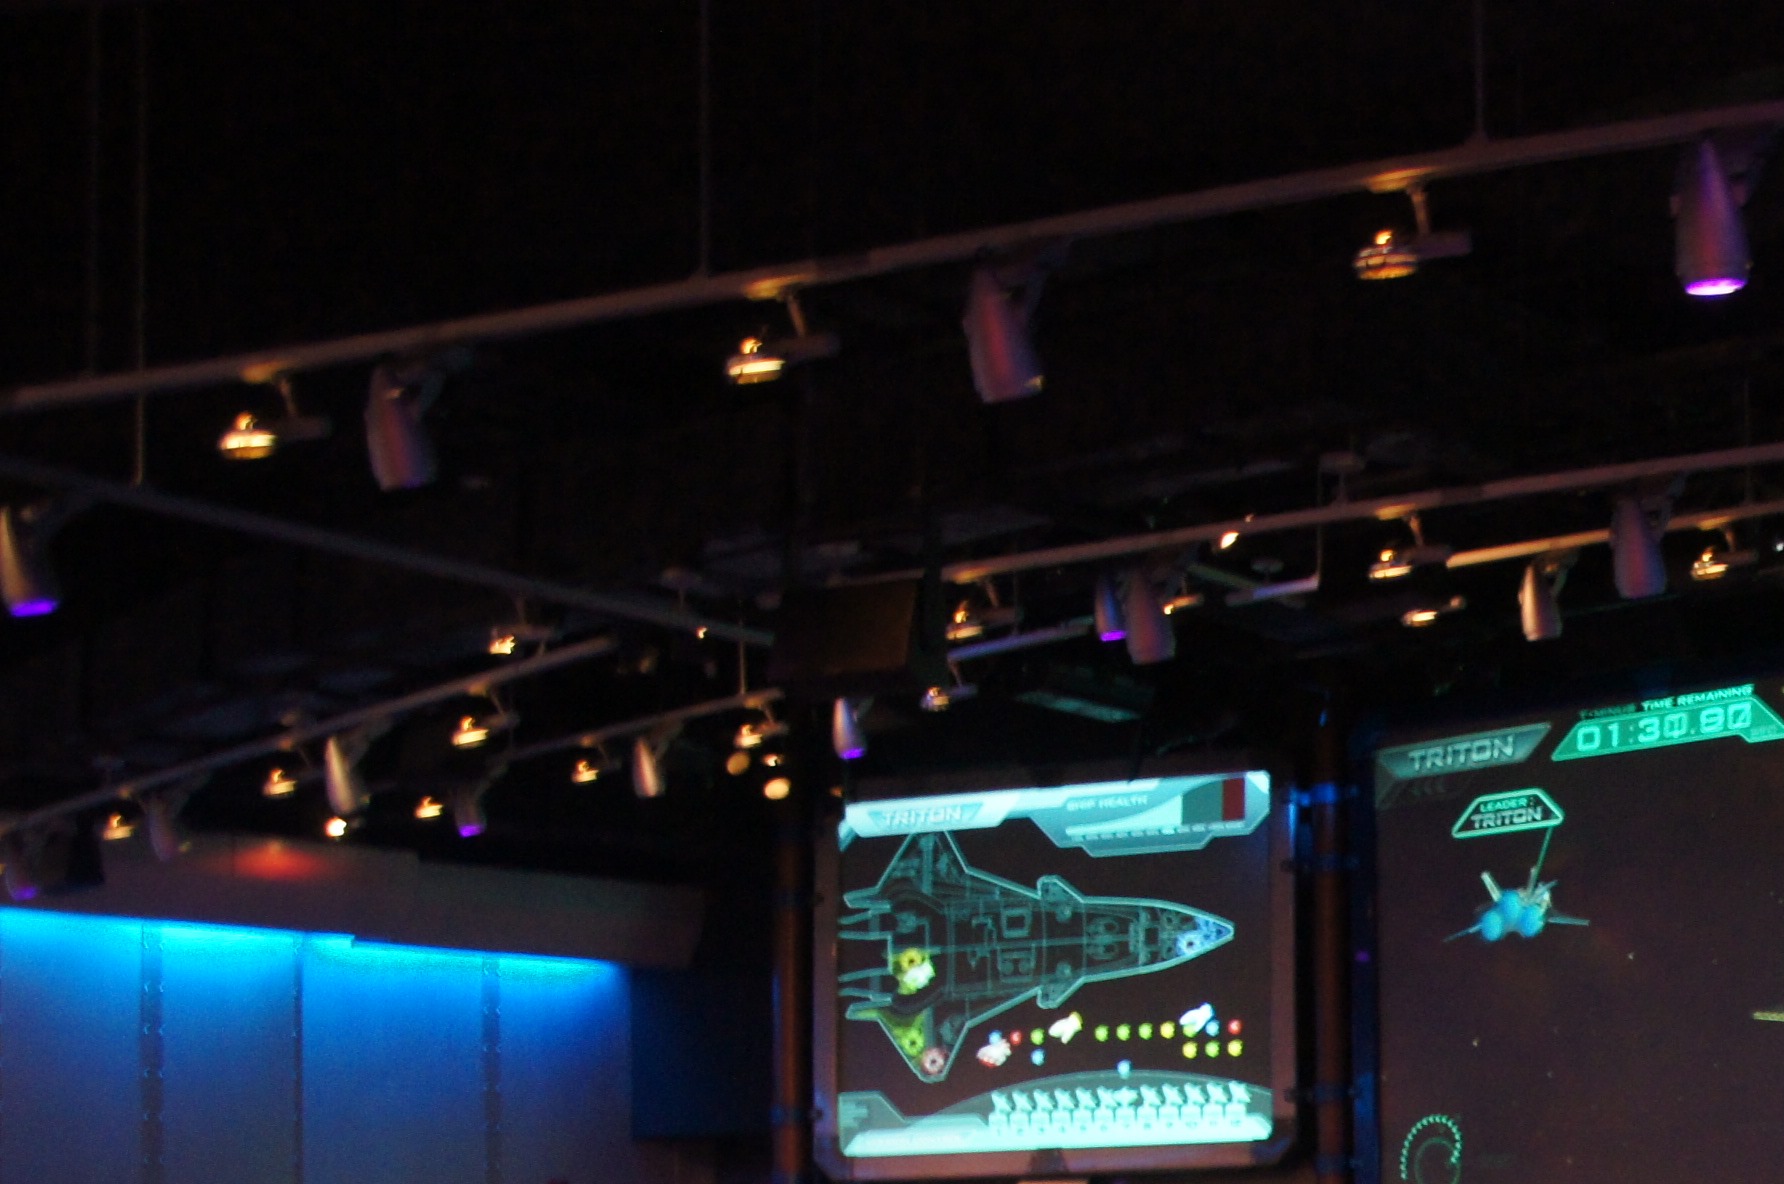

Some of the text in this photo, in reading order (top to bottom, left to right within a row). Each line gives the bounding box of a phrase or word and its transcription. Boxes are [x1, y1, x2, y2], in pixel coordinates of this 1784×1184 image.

[1641, 697, 1675, 711] TIME
[1676, 683, 1755, 706] REMAINING
[1408, 735, 1514, 771] TRITON
[881, 804, 963, 827] TRITON
[1470, 805, 1543, 829] TRITON
